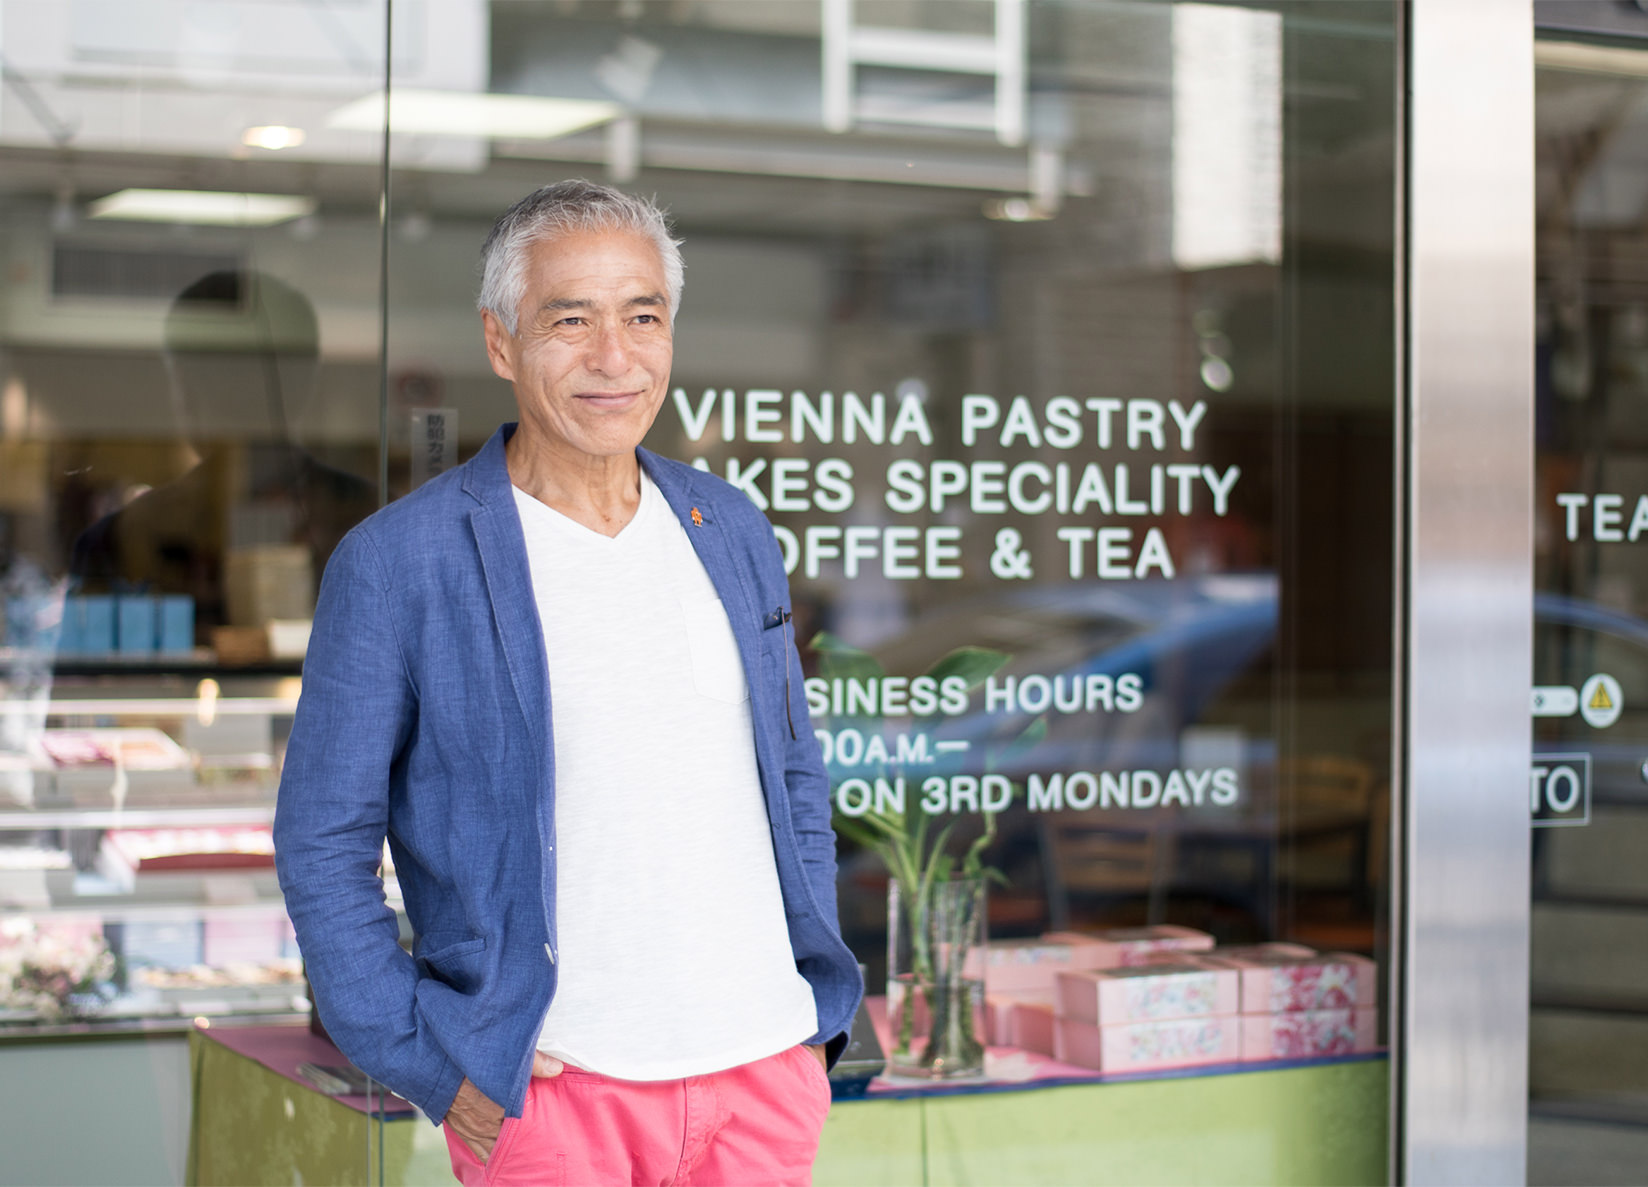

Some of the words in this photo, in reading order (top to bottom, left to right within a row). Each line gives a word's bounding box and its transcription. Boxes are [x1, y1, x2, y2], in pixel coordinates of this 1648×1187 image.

[673, 389, 932, 446] VIENNA
[963, 396, 1206, 451] PASTRY
[886, 460, 1239, 515] SPECIALITY
[990, 528, 1032, 579] &
[1057, 528, 1174, 579] TEA
[804, 677, 968, 716] SINESS
[986, 674, 1142, 714] HOURS
[837, 777, 905, 815] ON
[921, 775, 1012, 814] 3RD
[1028, 769, 1238, 810] MONDAYS
